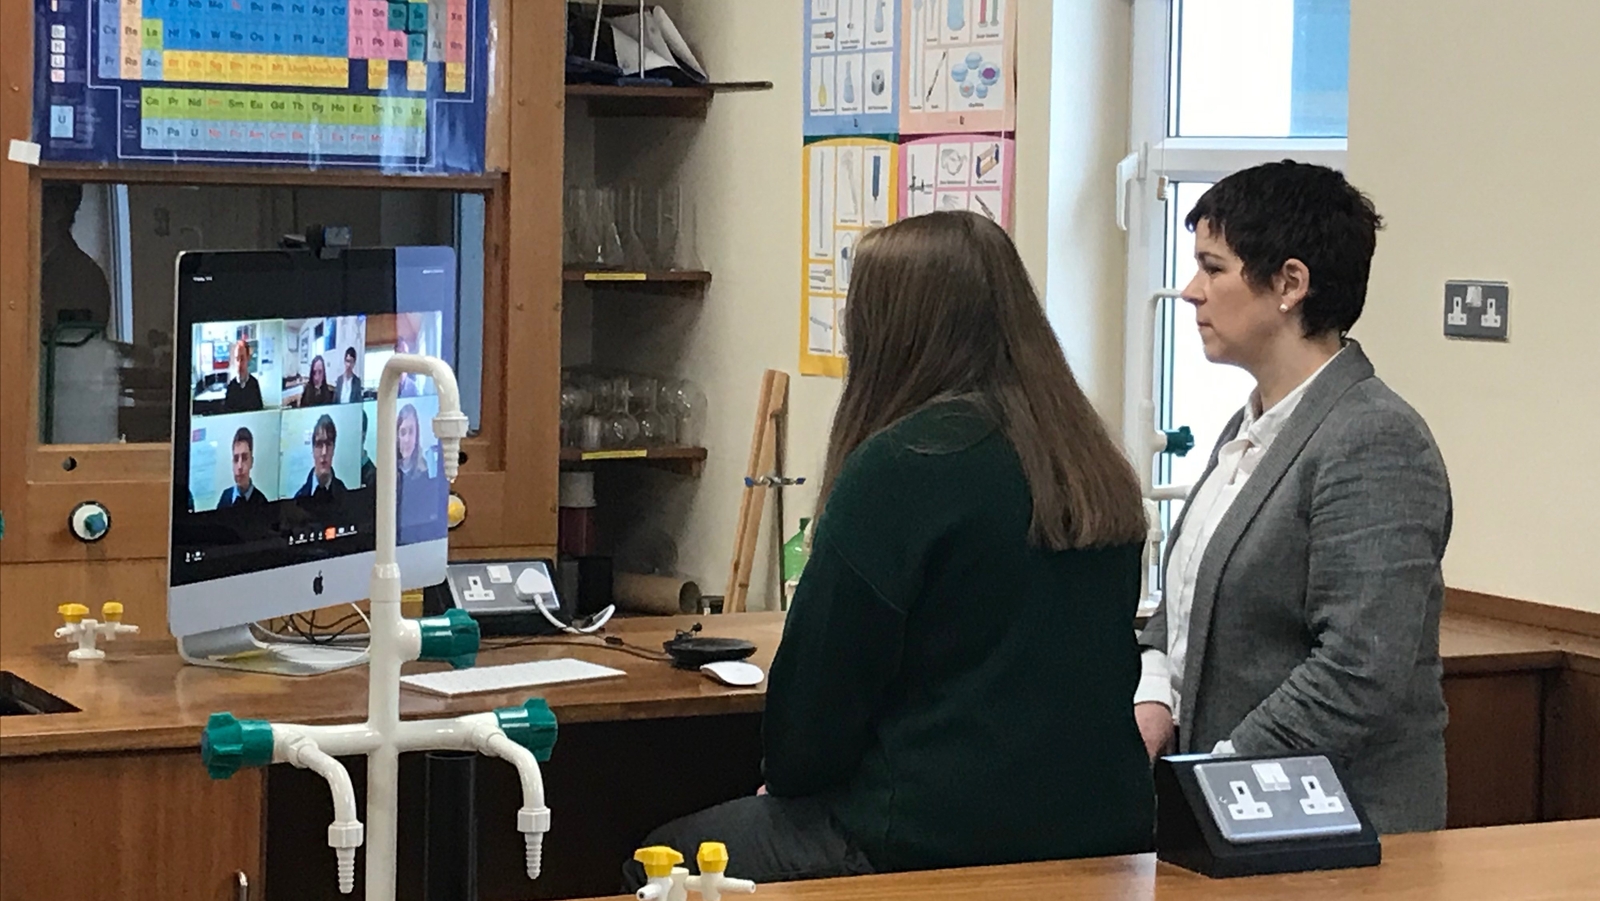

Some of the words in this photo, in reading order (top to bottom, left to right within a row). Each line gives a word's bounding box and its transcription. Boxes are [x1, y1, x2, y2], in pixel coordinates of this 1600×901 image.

[331, 5, 346, 16] Cd
[353, 7, 363, 16] In
[372, 8, 385, 17] Sn
[124, 25, 138, 36] Ba
[146, 27, 158, 37] La
[249, 31, 264, 42] Os
[372, 37, 385, 47] Pb
[168, 96, 179, 106] Pr
[187, 98, 202, 107] Nd
[228, 99, 244, 109] Sm
[250, 100, 264, 110] Eu
[292, 101, 304, 111] Tb
[311, 102, 324, 113] Dy
[331, 103, 345, 113] Ho
[353, 103, 364, 113] Er
[58, 114, 67, 125] U
[145, 126, 159, 136] Th
[167, 126, 180, 137] Pa
[190, 128, 199, 138] U
